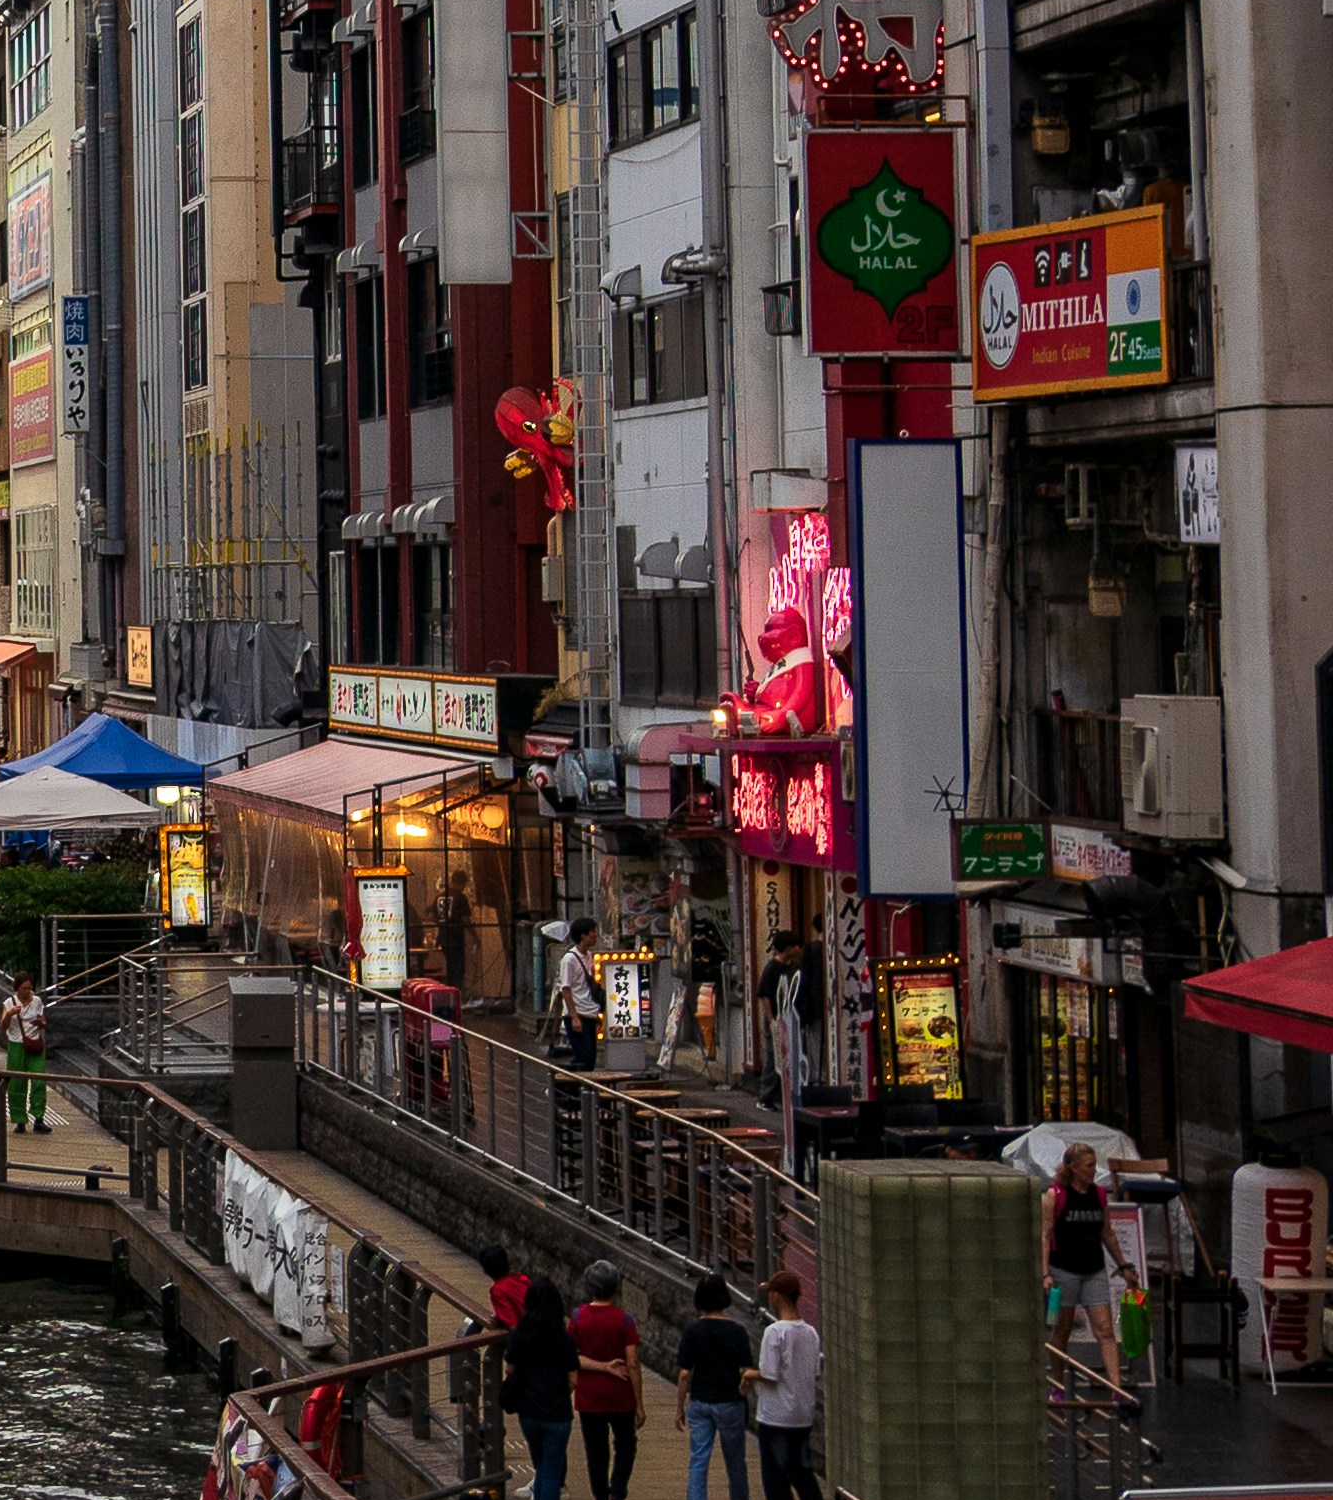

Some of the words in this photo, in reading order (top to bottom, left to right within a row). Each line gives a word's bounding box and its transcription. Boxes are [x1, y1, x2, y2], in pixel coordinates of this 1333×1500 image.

[850, 214, 922, 253] حلال
[858, 255, 918, 270] HALAL
[64, 301, 85, 343] 焼肉
[895, 305, 955, 344] 2F
[982, 283, 1019, 335] حلال
[1020, 292, 1105, 333] MITHILA
[987, 335, 1014, 351] HALAL
[1032, 346, 1059, 364] Indian
[1061, 342, 1091, 361] Cuisine
[1109, 330, 1128, 363] 2F
[65, 347, 86, 430] いろりや
[839, 898, 864, 982] NINJA
